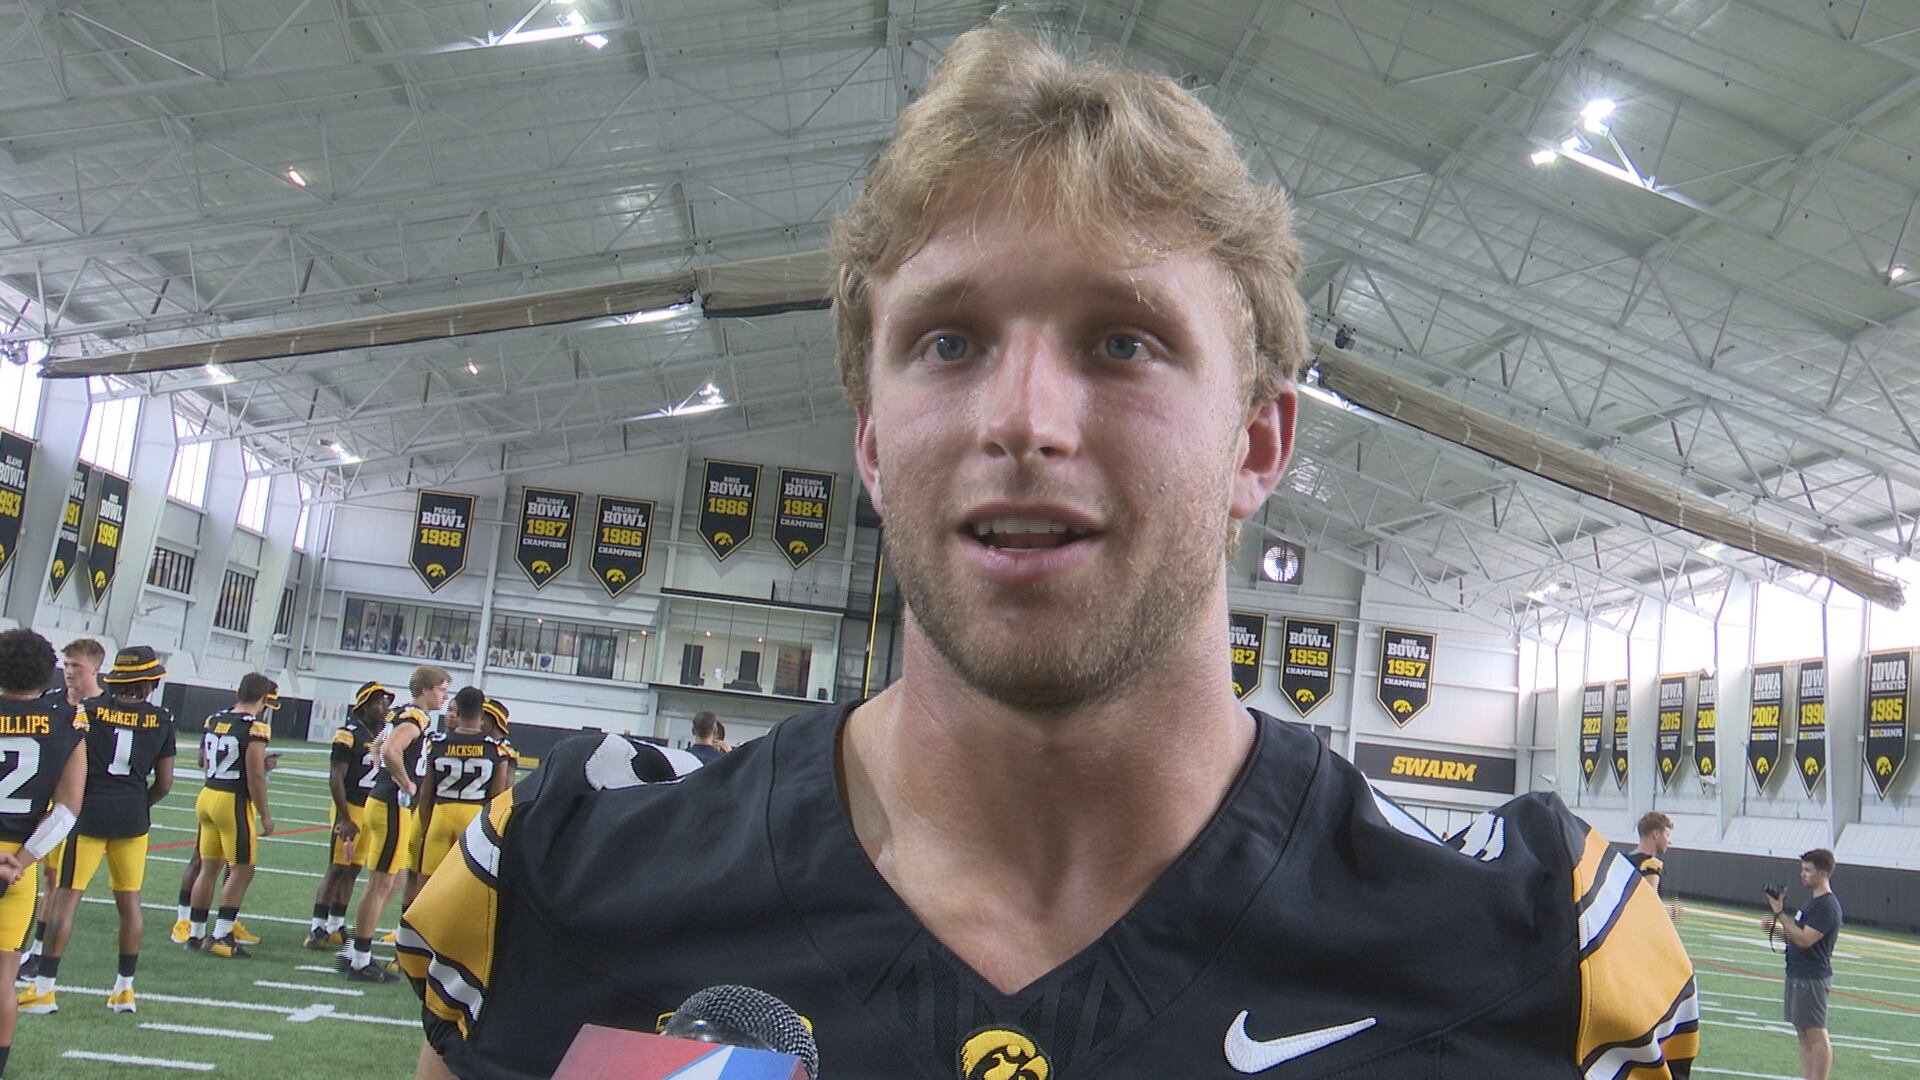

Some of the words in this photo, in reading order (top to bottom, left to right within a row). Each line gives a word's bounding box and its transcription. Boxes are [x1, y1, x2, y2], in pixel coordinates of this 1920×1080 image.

[709, 481, 752, 498] BOWL
[784, 482, 828, 500] BOWL
[100, 499, 123, 523] BOWL
[526, 502, 571, 519] BOWL
[536, 496, 564, 507] HOLIDAY
[708, 497, 749, 517] 1986
[783, 499, 824, 518] 1984
[421, 511, 465, 528] BOWL
[526, 518, 567, 538] 1987
[602, 511, 646, 528] BOWL
[780, 518, 824, 530] CHAMPIONS
[97, 521, 119, 548] 1991
[420, 528, 462, 548] 1988
[522, 538, 566, 550] CHAMPIONS
[601, 527, 643, 547] 1986
[598, 546, 642, 559] CHAMPIONS
[1289, 632, 1331, 648] BOWL
[1289, 648, 1328, 667] 1959
[1387, 643, 1429, 659] BOWL
[1286, 667, 1328, 679] CHAMPIONS
[1387, 659, 1425, 678] 1957
[1872, 660, 1906, 682] IOWA
[1384, 678, 1426, 690] CHAMPIONS
[1661, 682, 1683, 699] IOWA
[1754, 672, 1781, 692] IOWA
[1871, 680, 1906, 692] HAWKEYES
[96, 708, 138, 728] PARKER
[143, 714, 160, 728] JR.
[1752, 706, 1780, 727] 2002
[1871, 698, 1904, 722] 1985
[1660, 711, 1681, 731] 2015
[108, 729, 134, 776] 1
[445, 744, 484, 758] JACKSON
[1390, 756, 1477, 782] SWARM
[433, 758, 494, 801] 22
